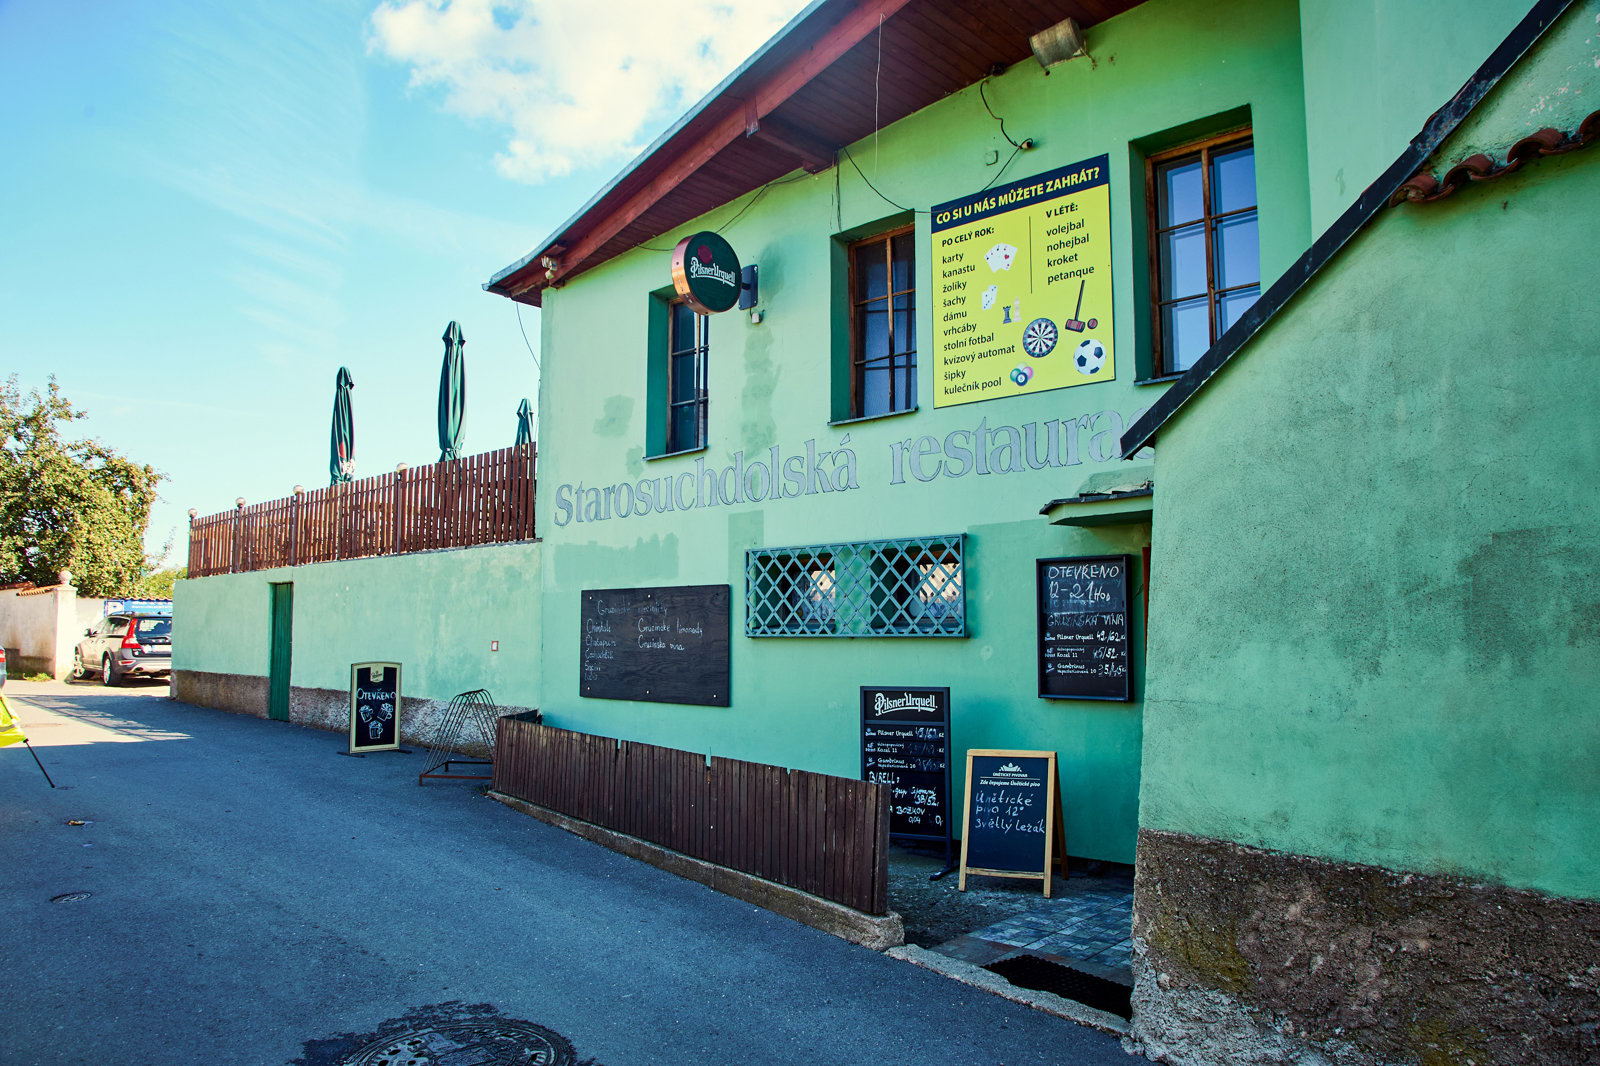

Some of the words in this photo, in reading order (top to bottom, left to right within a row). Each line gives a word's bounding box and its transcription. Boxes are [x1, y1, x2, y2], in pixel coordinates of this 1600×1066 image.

[937, 212, 951, 224] CO
[953, 208, 963, 220] SI
[964, 207, 972, 217] U
[974, 196, 996, 214] NÁS
[998, 184, 1044, 207] MŮŽETE
[1046, 167, 1100, 192] ZAHRÁT?
[1046, 210, 1052, 219] V
[1054, 202, 1078, 217] LÉTĚ:
[942, 238, 953, 247] PO
[955, 230, 973, 245] CELÝ
[975, 226, 994, 240] ROK:
[1046, 219, 1084, 237] volejbal
[1047, 234, 1089, 252] nohejbal
[942, 252, 964, 264] karty
[1047, 253, 1078, 268] kroket
[942, 264, 975, 278] kanastu
[1047, 265, 1094, 285] petanque
[943, 280, 967, 293] žolíky
[943, 295, 966, 308] šachy
[943, 310, 967, 322] dámu
[944, 322, 977, 337] vrhcáby
[944, 337, 967, 351] stolní
[969, 333, 994, 346] fotbal
[944, 350, 976, 366] kvízový
[978, 345, 1015, 360] automat
[944, 369, 966, 381] šipky
[944, 381, 979, 395] kulečník
[982, 377, 1002, 391] pool
[554, 432, 860, 526] Starosuchdolská
[889, 407, 1154, 486] restaura
[1048, 565, 1119, 580] OTEVŘENO
